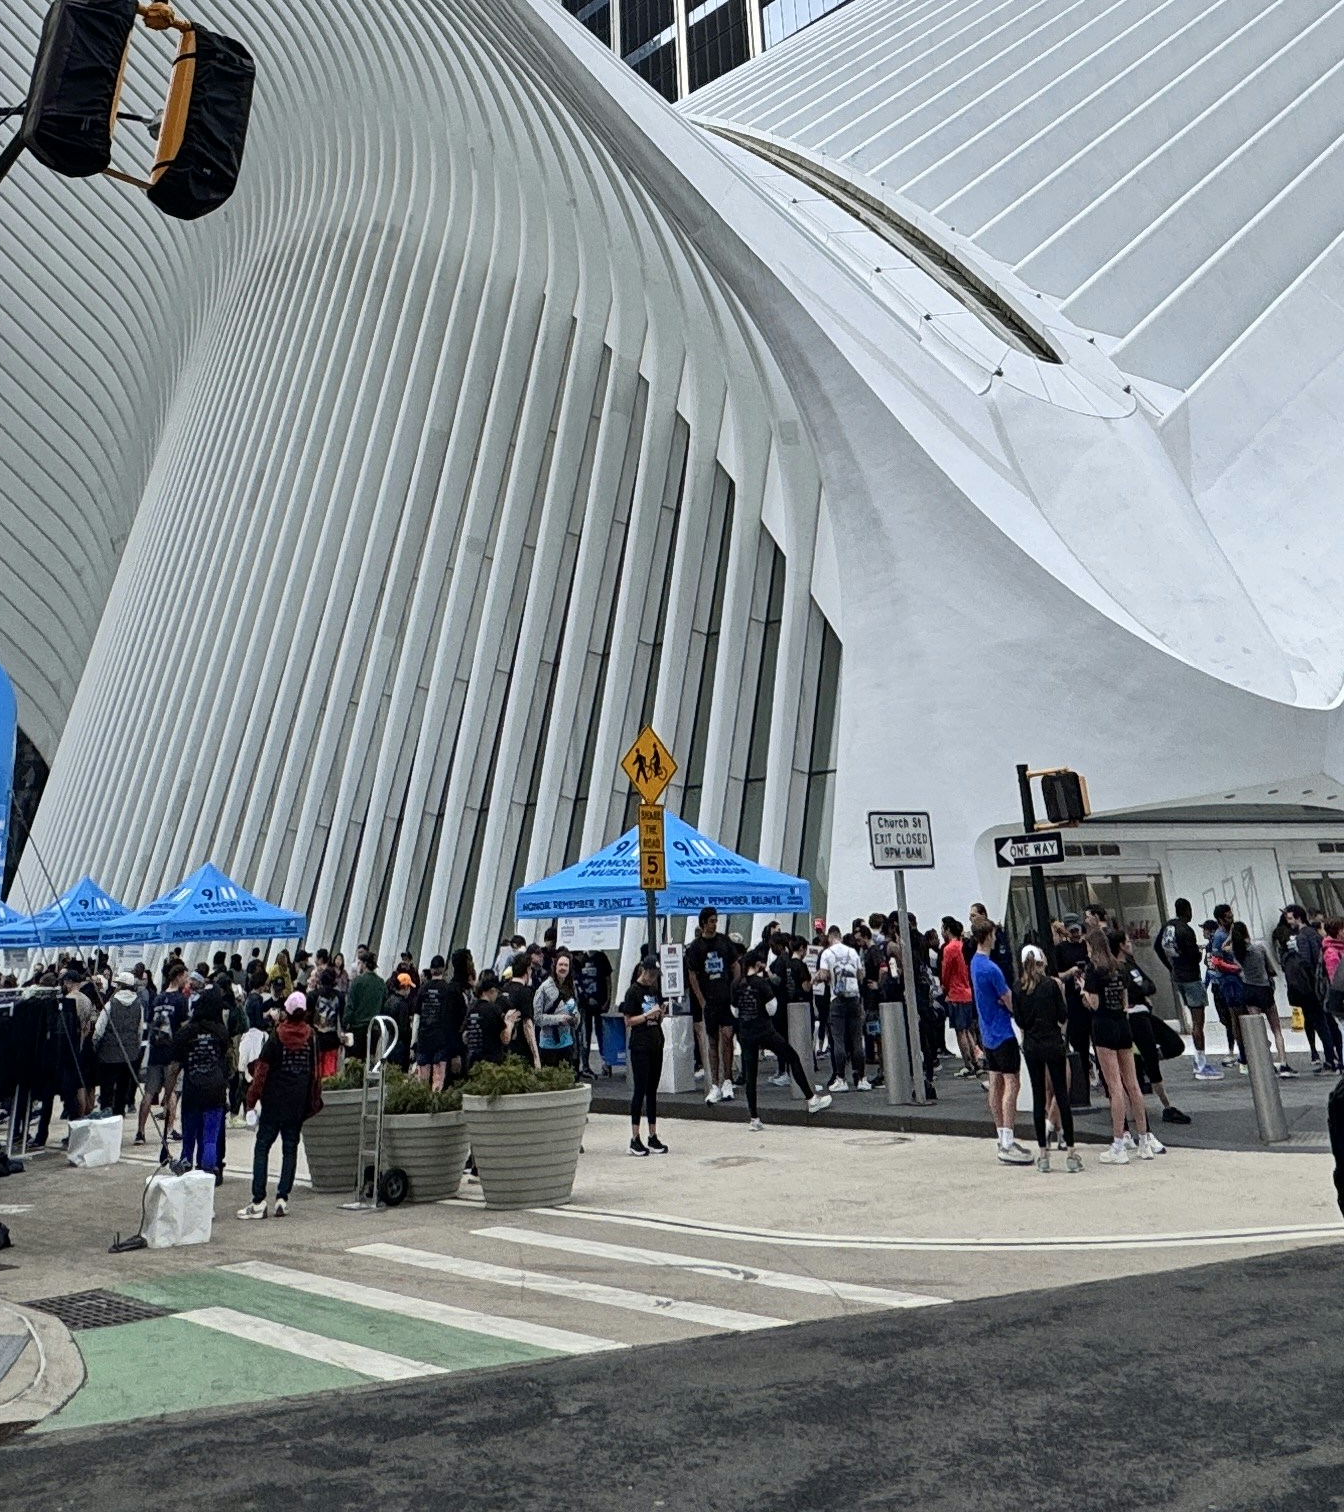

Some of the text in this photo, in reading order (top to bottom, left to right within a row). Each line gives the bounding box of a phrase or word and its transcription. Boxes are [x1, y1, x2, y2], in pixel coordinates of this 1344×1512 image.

[878, 817, 922, 829] Church St
[875, 833, 928, 845] EXIT CLOSED
[612, 840, 640, 858] 9/1
[672, 837, 716, 858] 9/11
[1010, 841, 1056, 857] ONE WAY
[647, 855, 658, 875] 5
[201, 885, 238, 901] 9/11
[78, 896, 111, 910] 9/11
[193, 899, 257, 910] MEMORIAL
